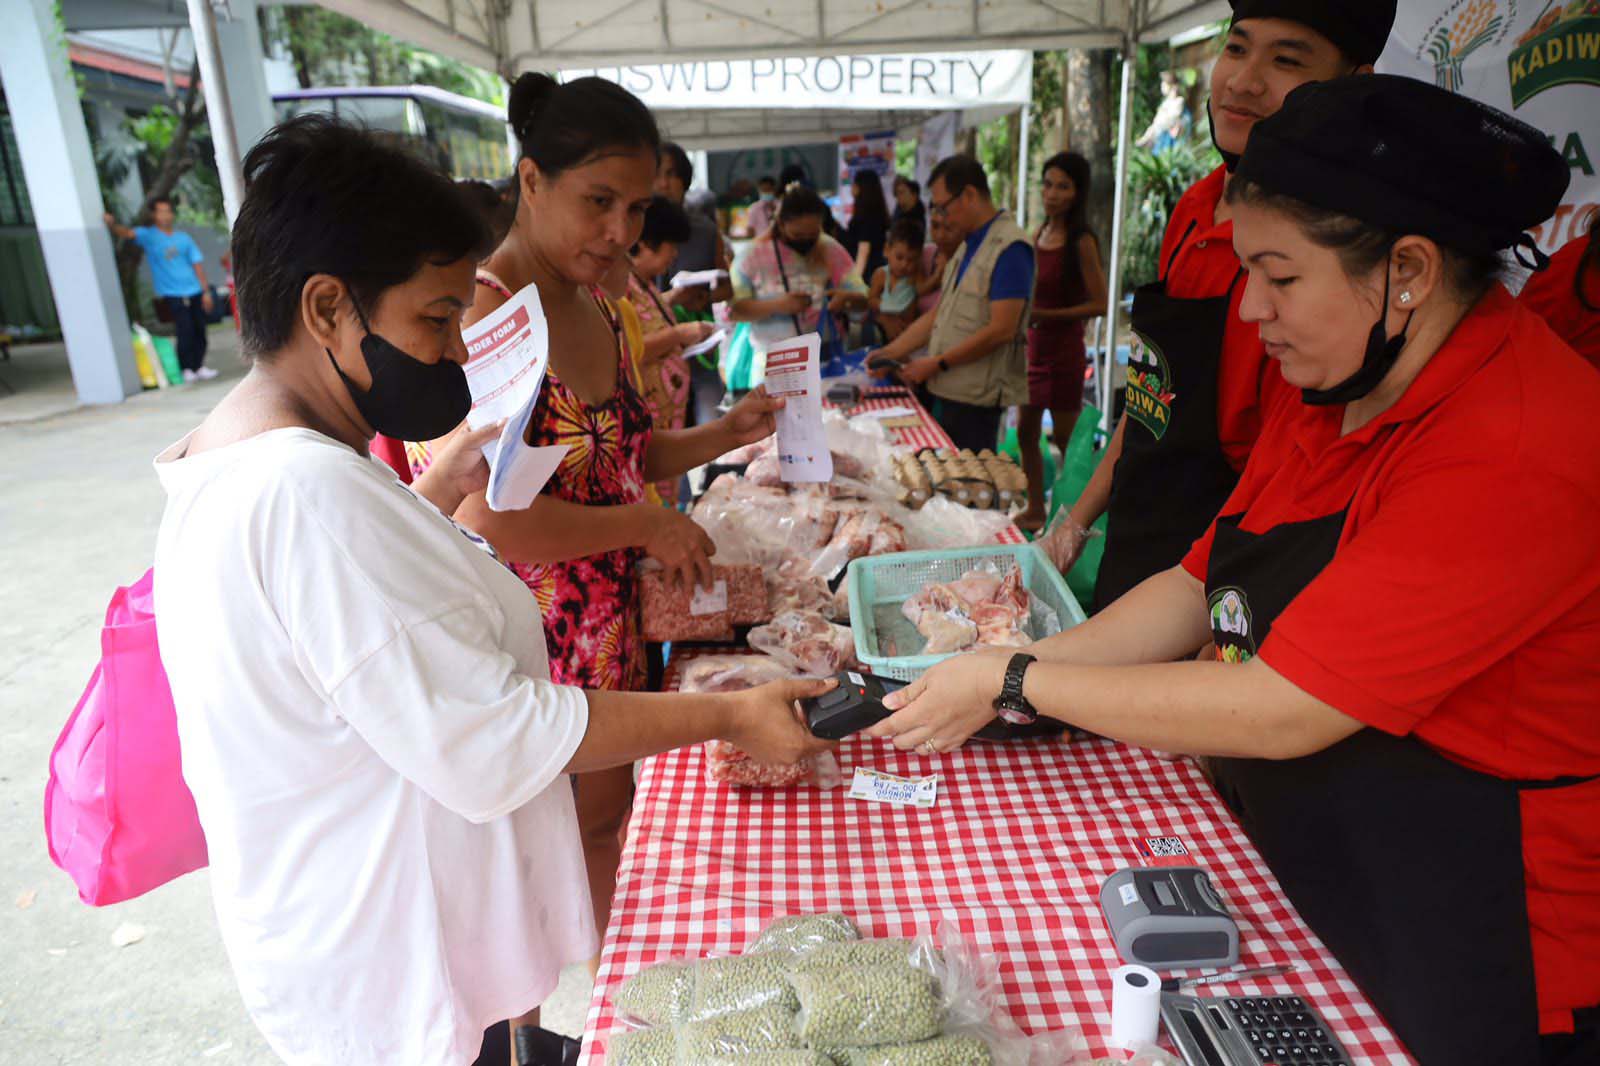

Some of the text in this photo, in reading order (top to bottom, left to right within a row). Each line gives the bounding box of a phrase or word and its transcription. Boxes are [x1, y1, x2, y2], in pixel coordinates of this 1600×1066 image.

[751, 56, 993, 94] PROPERTY
[468, 336, 493, 355] RDER
[494, 319, 516, 342] FORM
[1126, 386, 1166, 424] DIWA
